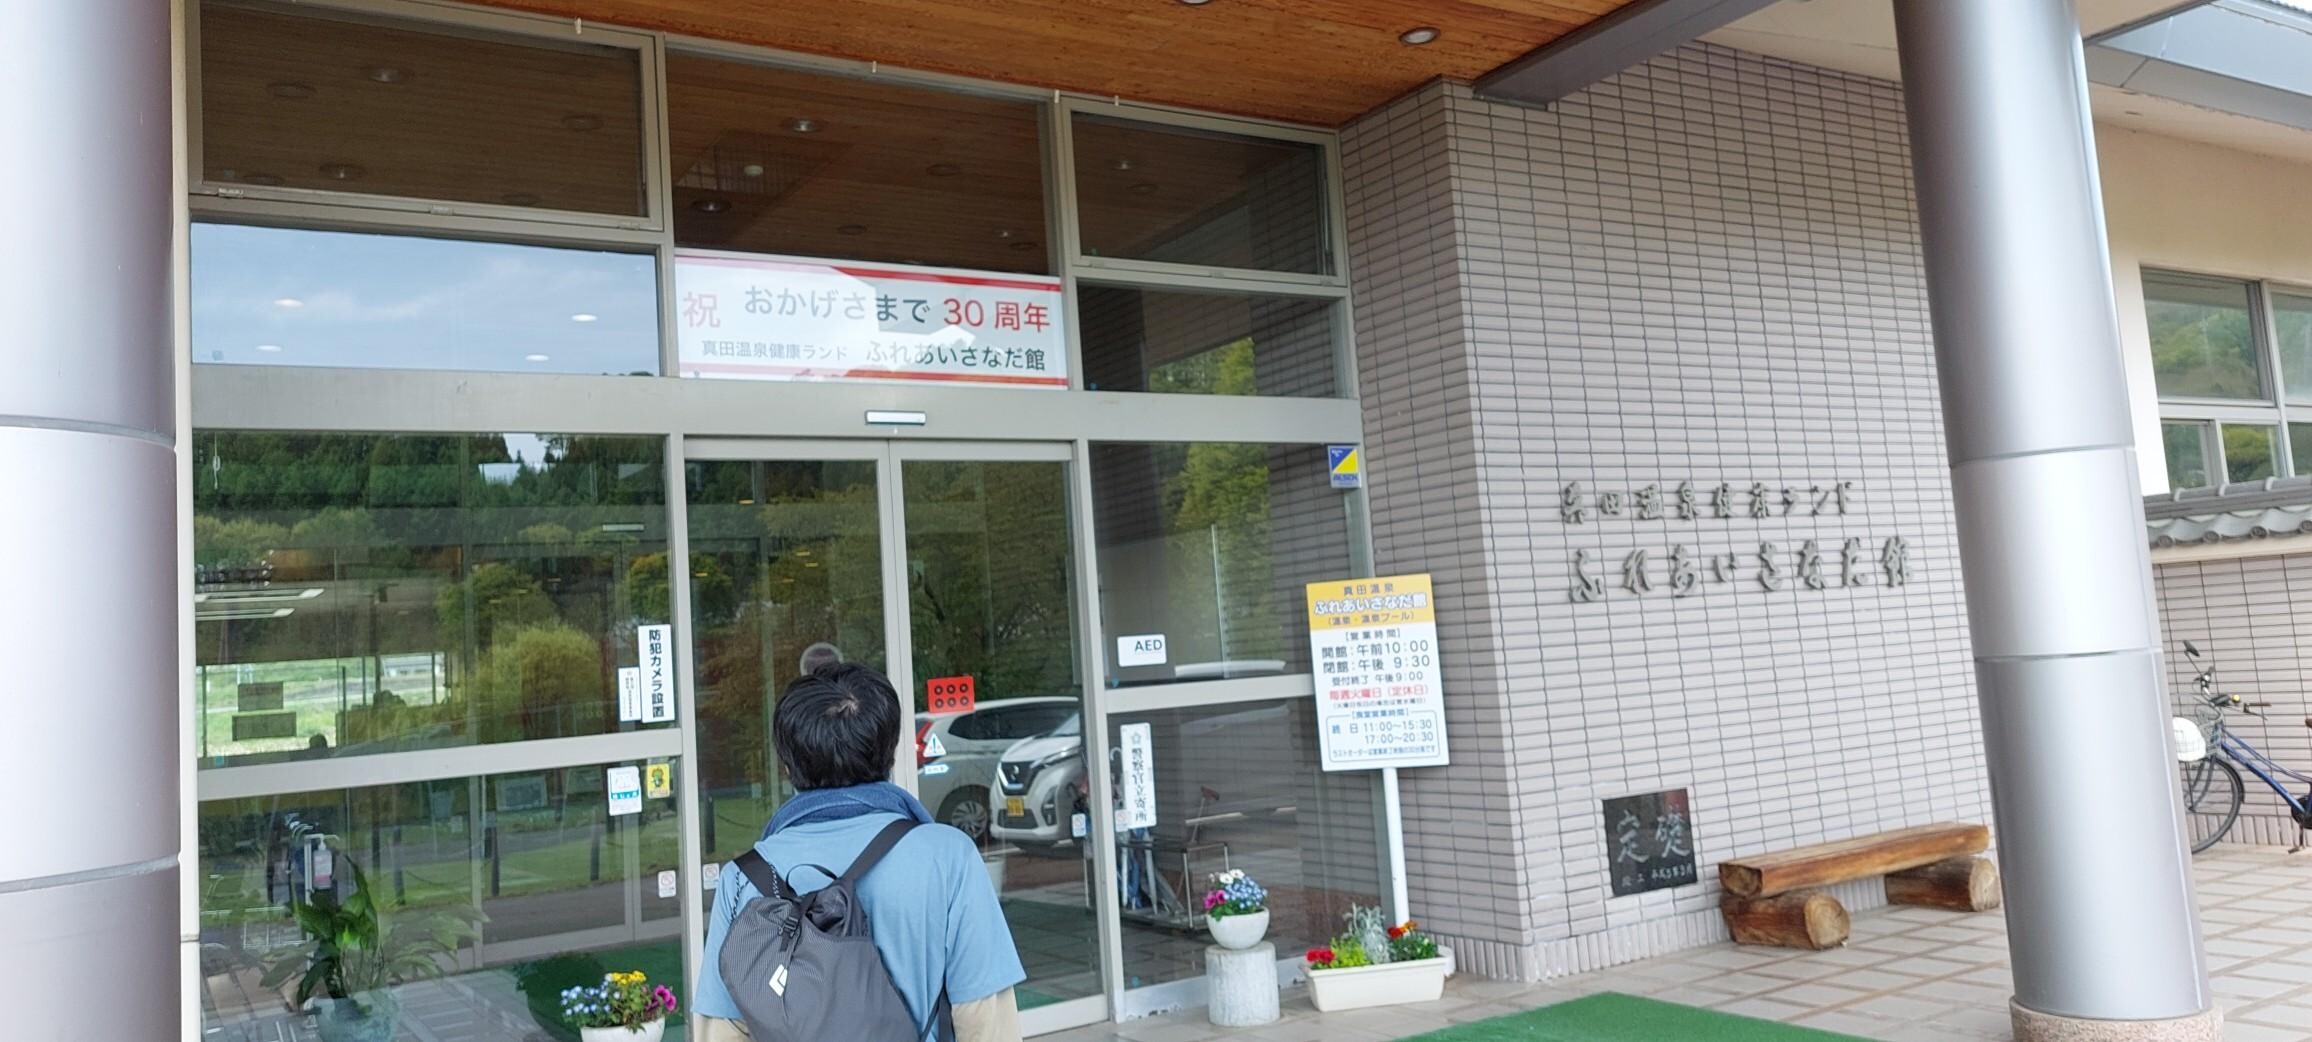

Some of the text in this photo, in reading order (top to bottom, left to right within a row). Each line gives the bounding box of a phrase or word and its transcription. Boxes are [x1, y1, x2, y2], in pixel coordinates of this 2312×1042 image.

[683, 285, 1051, 333] 祝 おかげさまで 30 周年
[701, 340, 1045, 371] 真田温泉健康ランド ふれあいさなだ館
[1134, 639, 1164, 652] AED
[648, 628, 666, 719] 防犯カメラ設置
